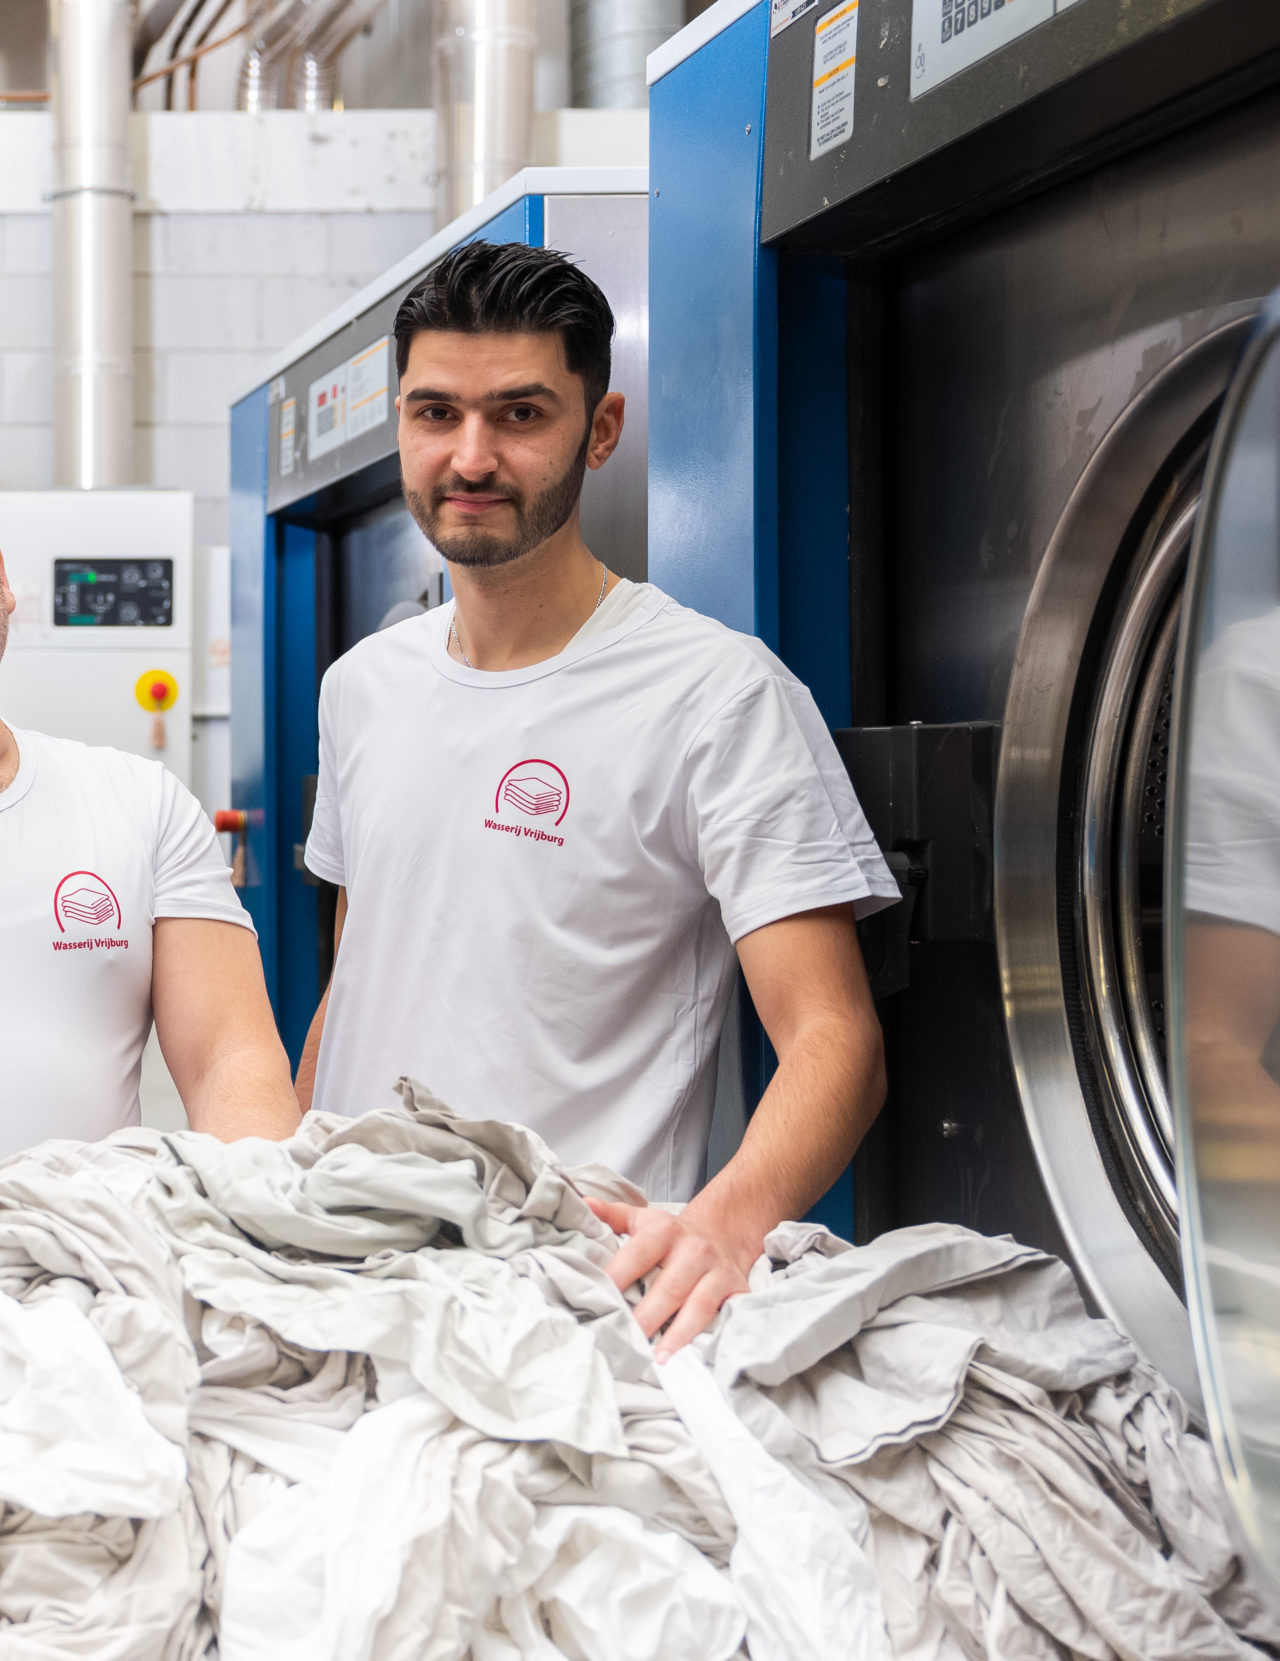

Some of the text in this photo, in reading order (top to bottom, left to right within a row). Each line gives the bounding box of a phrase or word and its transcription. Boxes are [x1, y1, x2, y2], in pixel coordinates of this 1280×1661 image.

[956, 12, 963, 30] 7
[969, 4, 976, 22] 8
[484, 818, 565, 847] Wasserij Vrijburg
[52, 937, 129, 951] Wasserij Vrijburg
